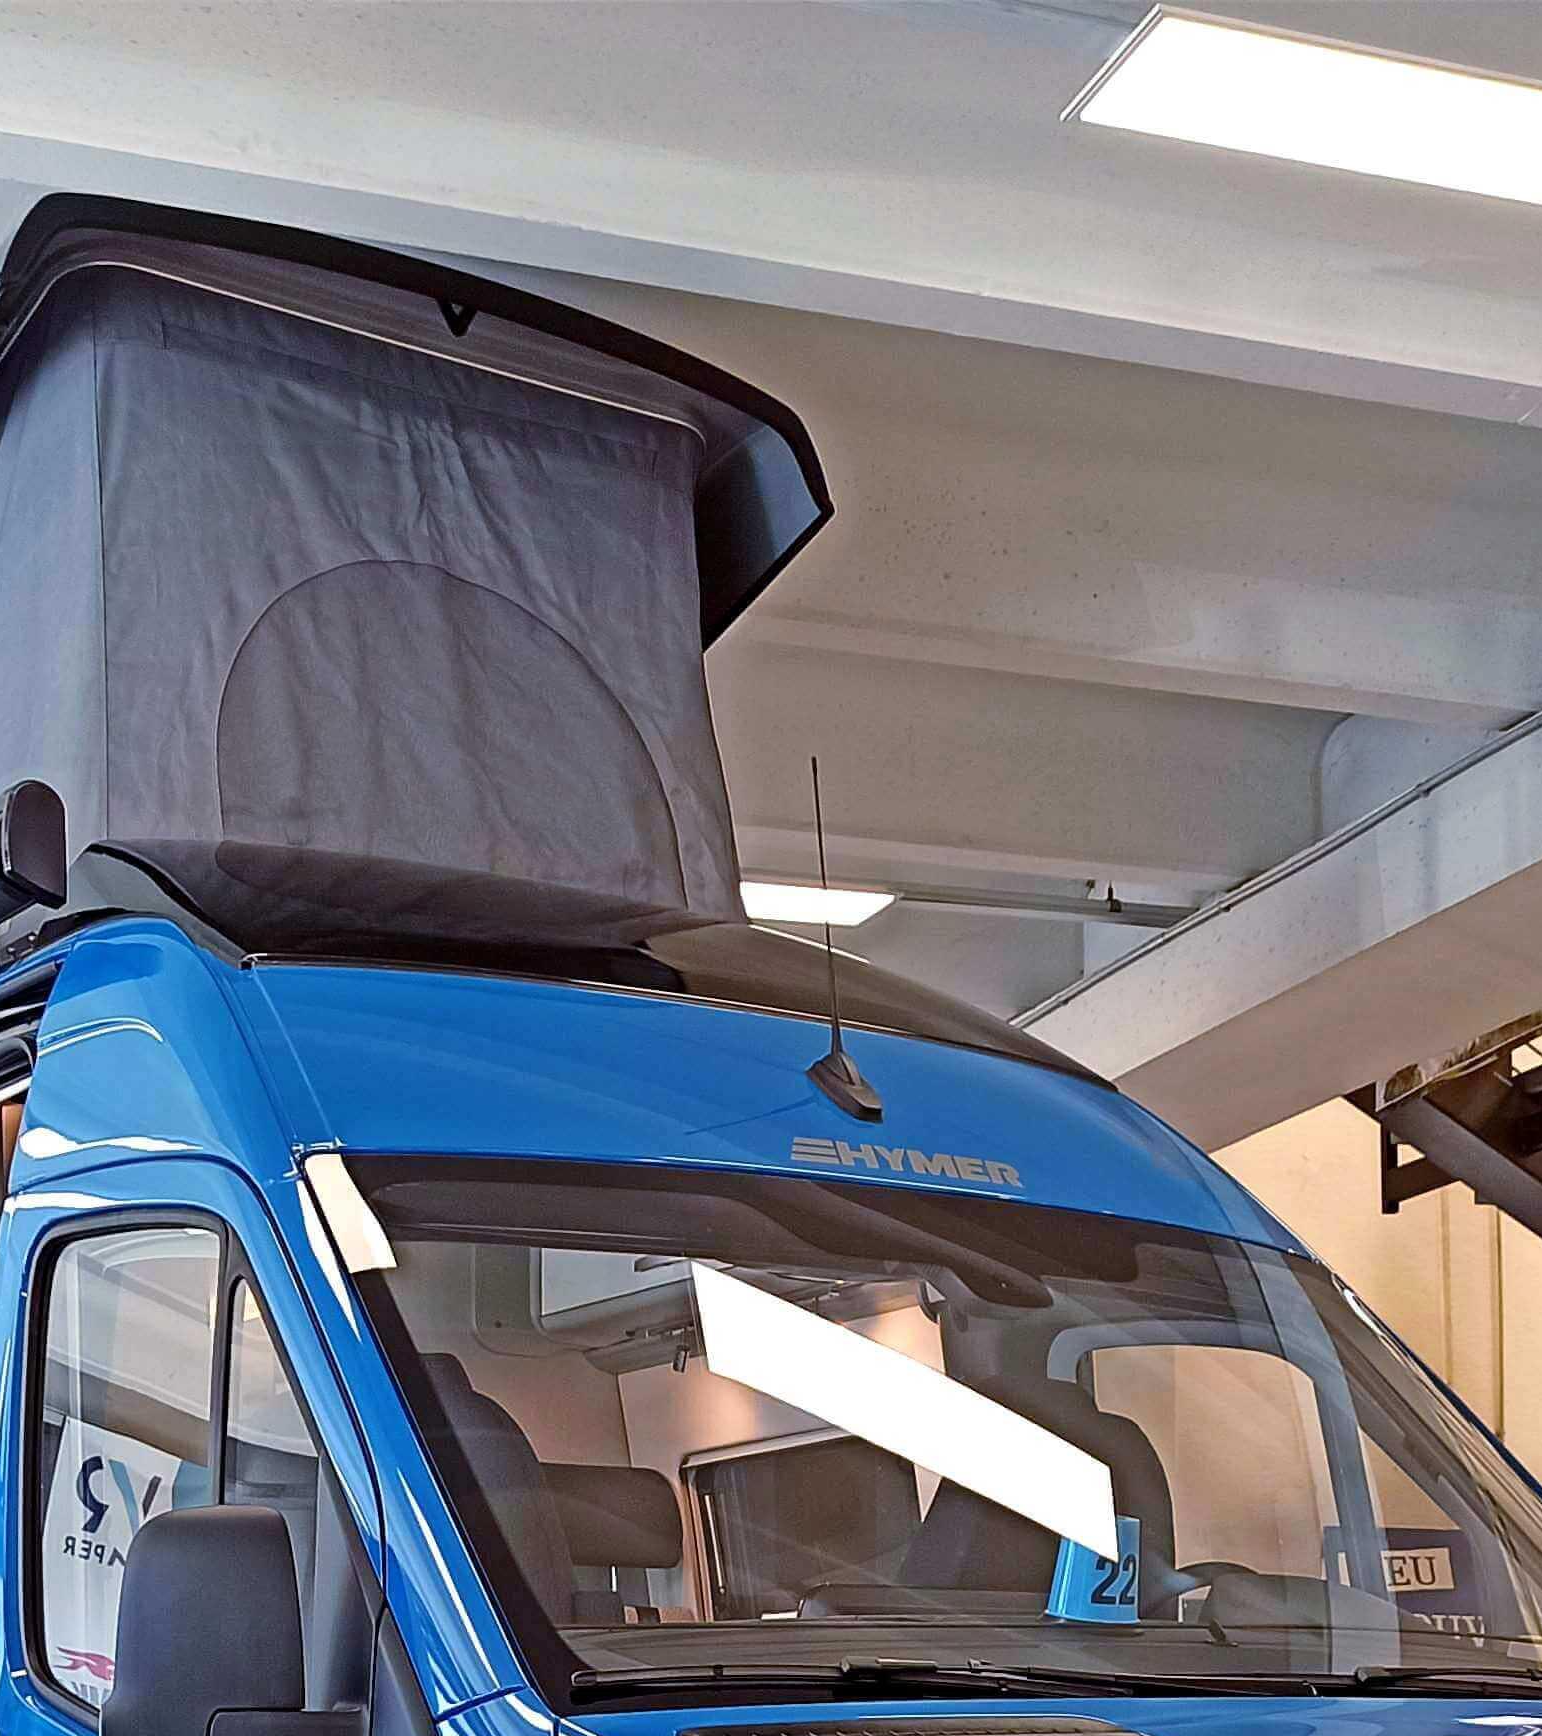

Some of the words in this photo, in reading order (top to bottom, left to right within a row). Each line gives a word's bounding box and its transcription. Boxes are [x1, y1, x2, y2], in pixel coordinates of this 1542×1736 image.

[837, 1140, 1023, 1188] HYMER
[1091, 1551, 1138, 1606] 22
[1384, 1555, 1437, 1588] EU
